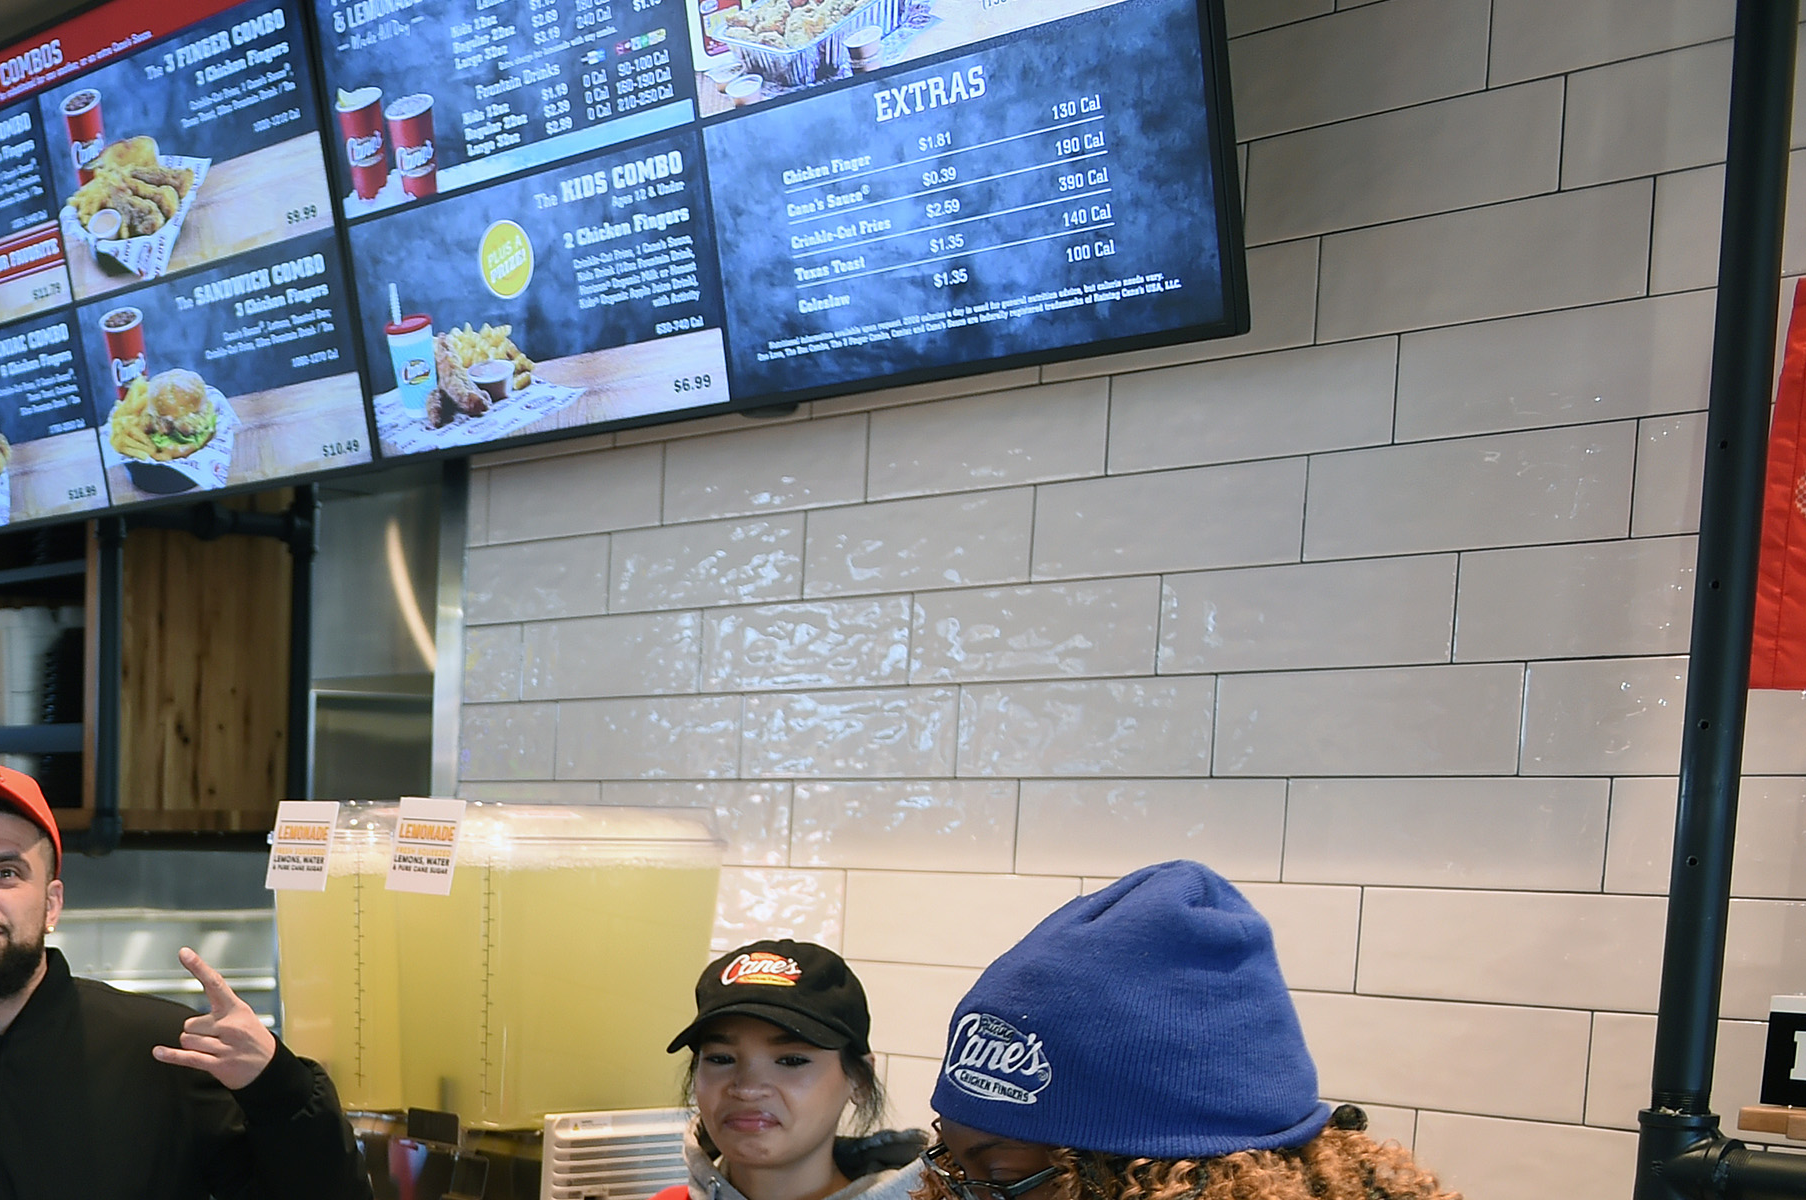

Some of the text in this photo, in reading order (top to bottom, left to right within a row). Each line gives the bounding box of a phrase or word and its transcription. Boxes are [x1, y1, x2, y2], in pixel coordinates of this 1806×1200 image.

[163, 53, 176, 73] 3
[175, 30, 232, 69] FINGER
[231, 8, 286, 46] COMBO
[204, 58, 247, 83] Chicken
[246, 41, 290, 67] Fingers
[591, 49, 670, 85] Cal Cal
[475, 62, 561, 100] Fountain Drinks
[593, 85, 610, 102] Cal
[655, 66, 672, 83] Cal
[873, 64, 987, 123] EXTRAS
[595, 102, 612, 119] Cal
[658, 83, 674, 100] Cal
[1, 139, 35, 160] Fingers
[782, 94, 1102, 186] Chicken Finger $1.81 130 Cal
[533, 150, 684, 209] The KIDS COMBO
[786, 131, 1105, 218] Cane's $0.39 190 Cal
[791, 167, 1109, 250] Crinkle-Cut Fries $2.59 390 Cal
[562, 207, 690, 249] 2 Chicken Fingers
[794, 203, 1112, 282] Texas Toast $1.35 140 Cal
[8, 238, 60, 267] FAVORITE
[193, 268, 271, 306] SANDWICH
[271, 253, 326, 285] COMBO
[798, 239, 1116, 314] Coleslaw $1.35 100 Cal
[244, 283, 329, 315] Chicken Fingers
[27, 323, 70, 351] COMBO
[39, 350, 73, 367] Fingers
[674, 374, 712, 393] $6.99
[277, 824, 330, 842] LEMONADE
[398, 823, 456, 842] LEMONADE
[273, 854, 325, 865] LEMONS, WATER
[393, 854, 450, 867] LEMONS, WATER
[721, 953, 802, 986] Cane's
[945, 1013, 1050, 1076] Cane's
[959, 1070, 1029, 1103] CHICKEN FINGERS
